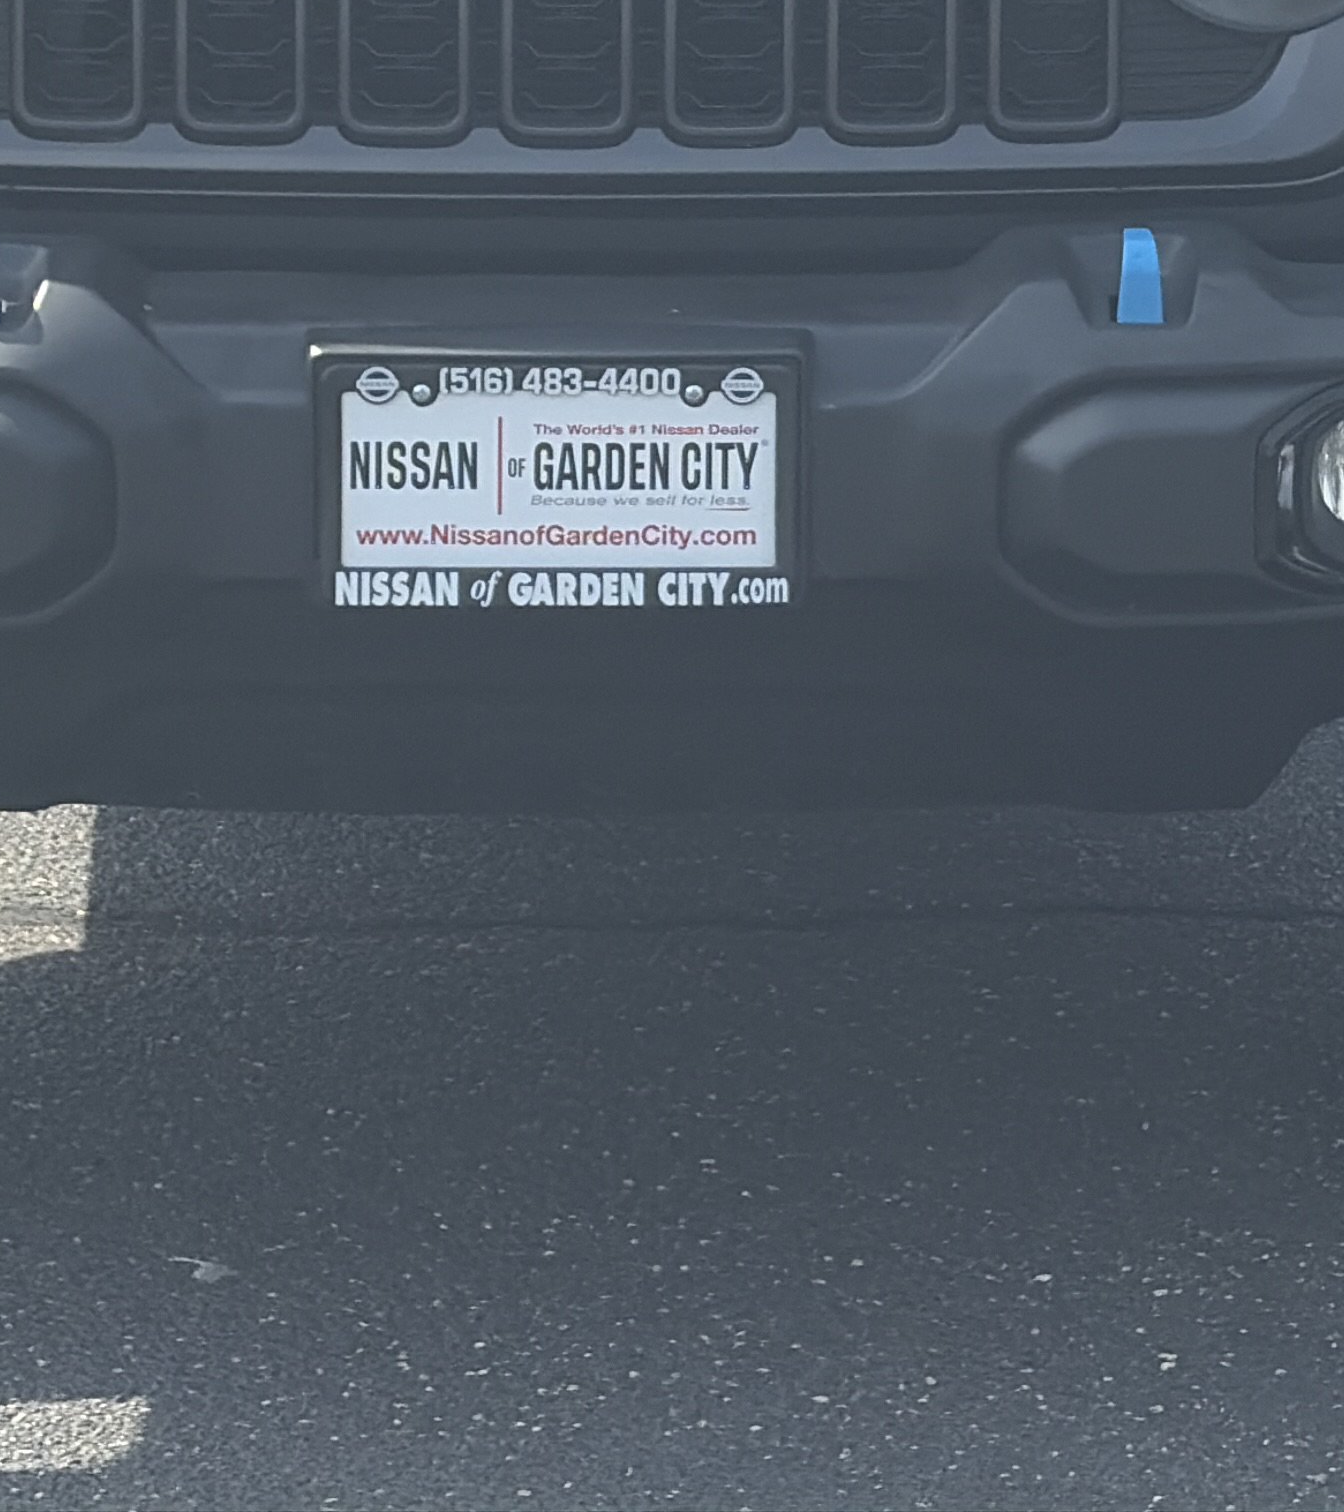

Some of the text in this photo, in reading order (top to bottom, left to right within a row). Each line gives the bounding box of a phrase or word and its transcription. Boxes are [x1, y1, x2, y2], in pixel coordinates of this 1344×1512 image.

[439, 367, 681, 396] (516) 483-4400
[533, 424, 759, 435] The World's #1 Nissan Dealer
[350, 441, 758, 490] NISSAN OF GARDEN CITY
[530, 494, 750, 506] Because we sell for less.
[356, 524, 757, 549] www.NissanofGardenCity.com
[334, 571, 459, 606] NISSAN
[470, 570, 503, 608] of
[507, 572, 645, 606] GARDEN
